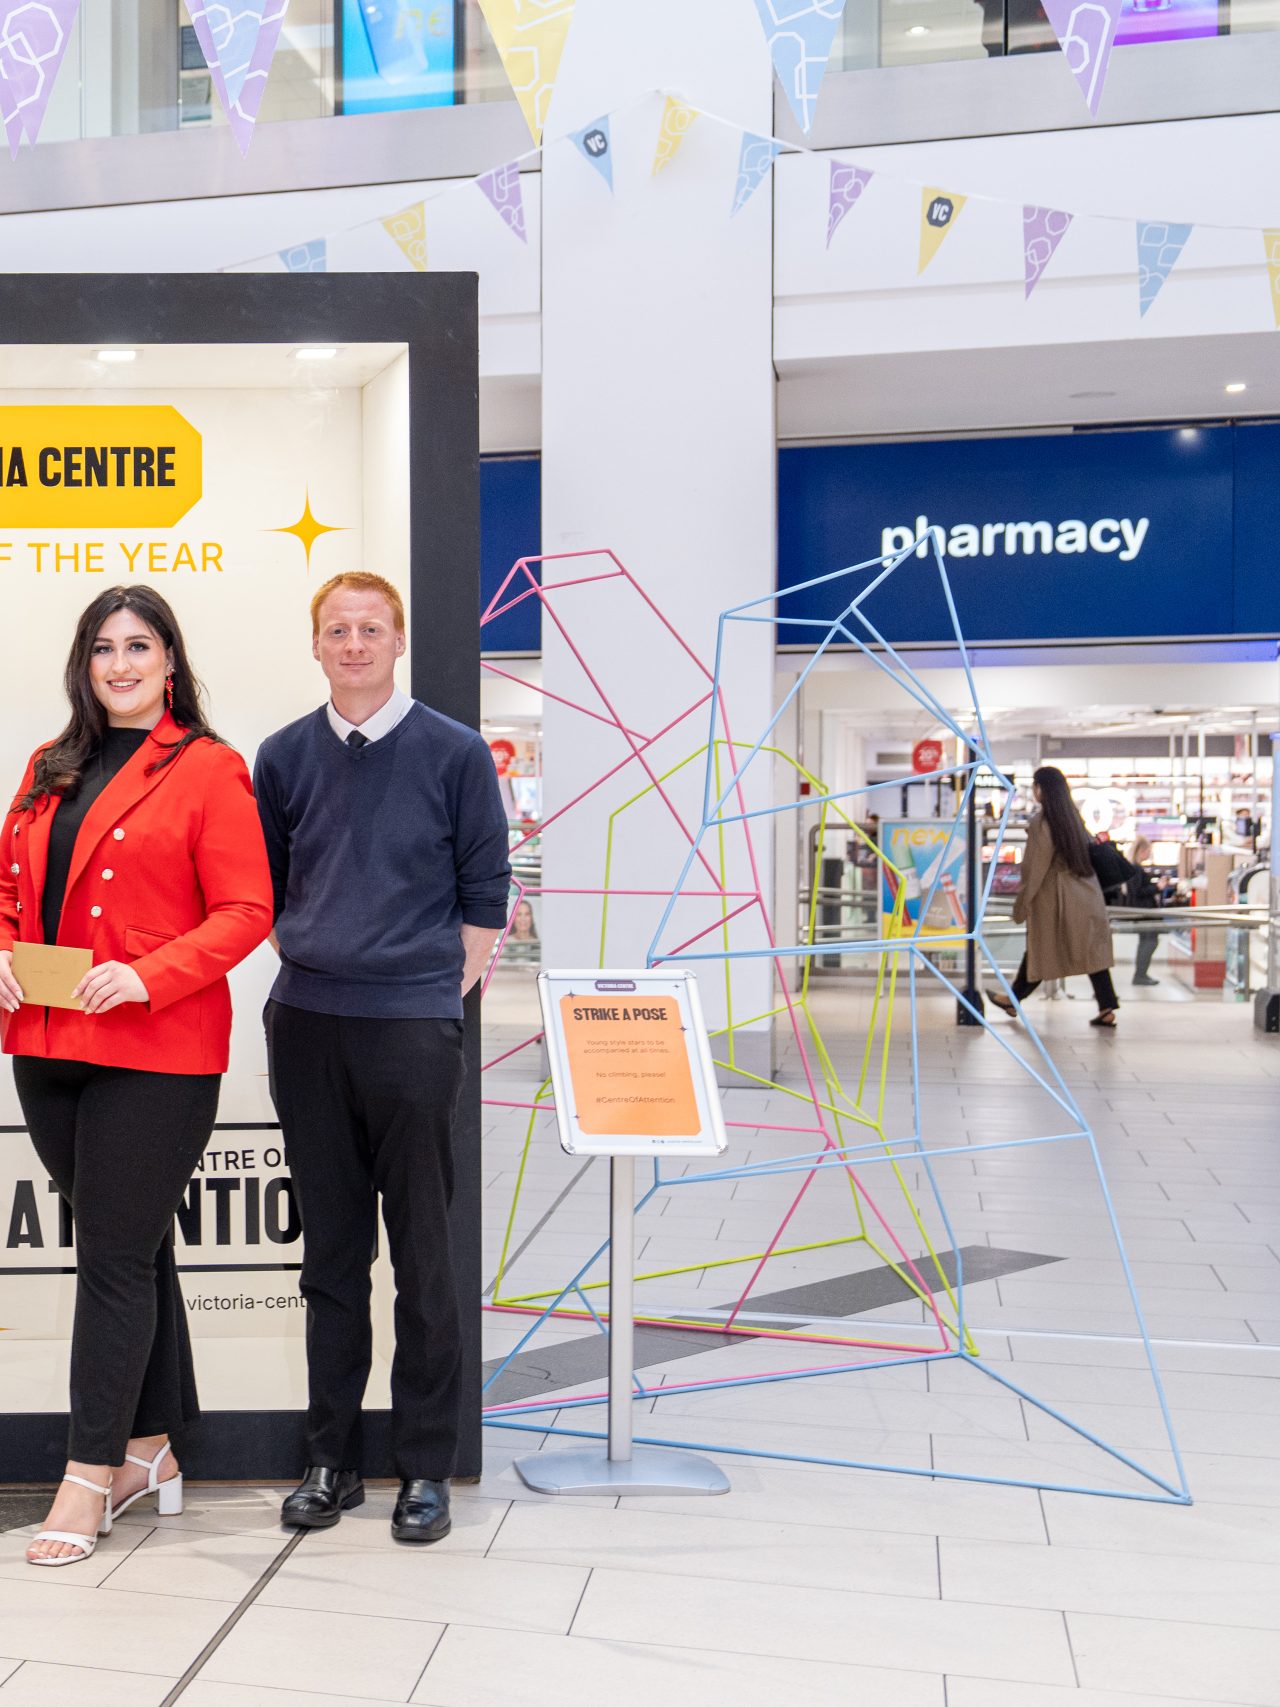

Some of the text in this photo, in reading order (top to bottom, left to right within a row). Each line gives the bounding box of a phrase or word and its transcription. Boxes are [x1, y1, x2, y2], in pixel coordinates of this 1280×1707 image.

[586, 134, 605, 153] VC
[932, 202, 950, 221] VC
[38, 446, 176, 487] CENTRE
[880, 515, 1150, 569] pharmacy
[27, 542, 105, 573] THE
[119, 542, 224, 573] YEAR
[573, 1008, 668, 1021] STRIKE A POSE
[186, 1293, 306, 1311] victoria-cent
